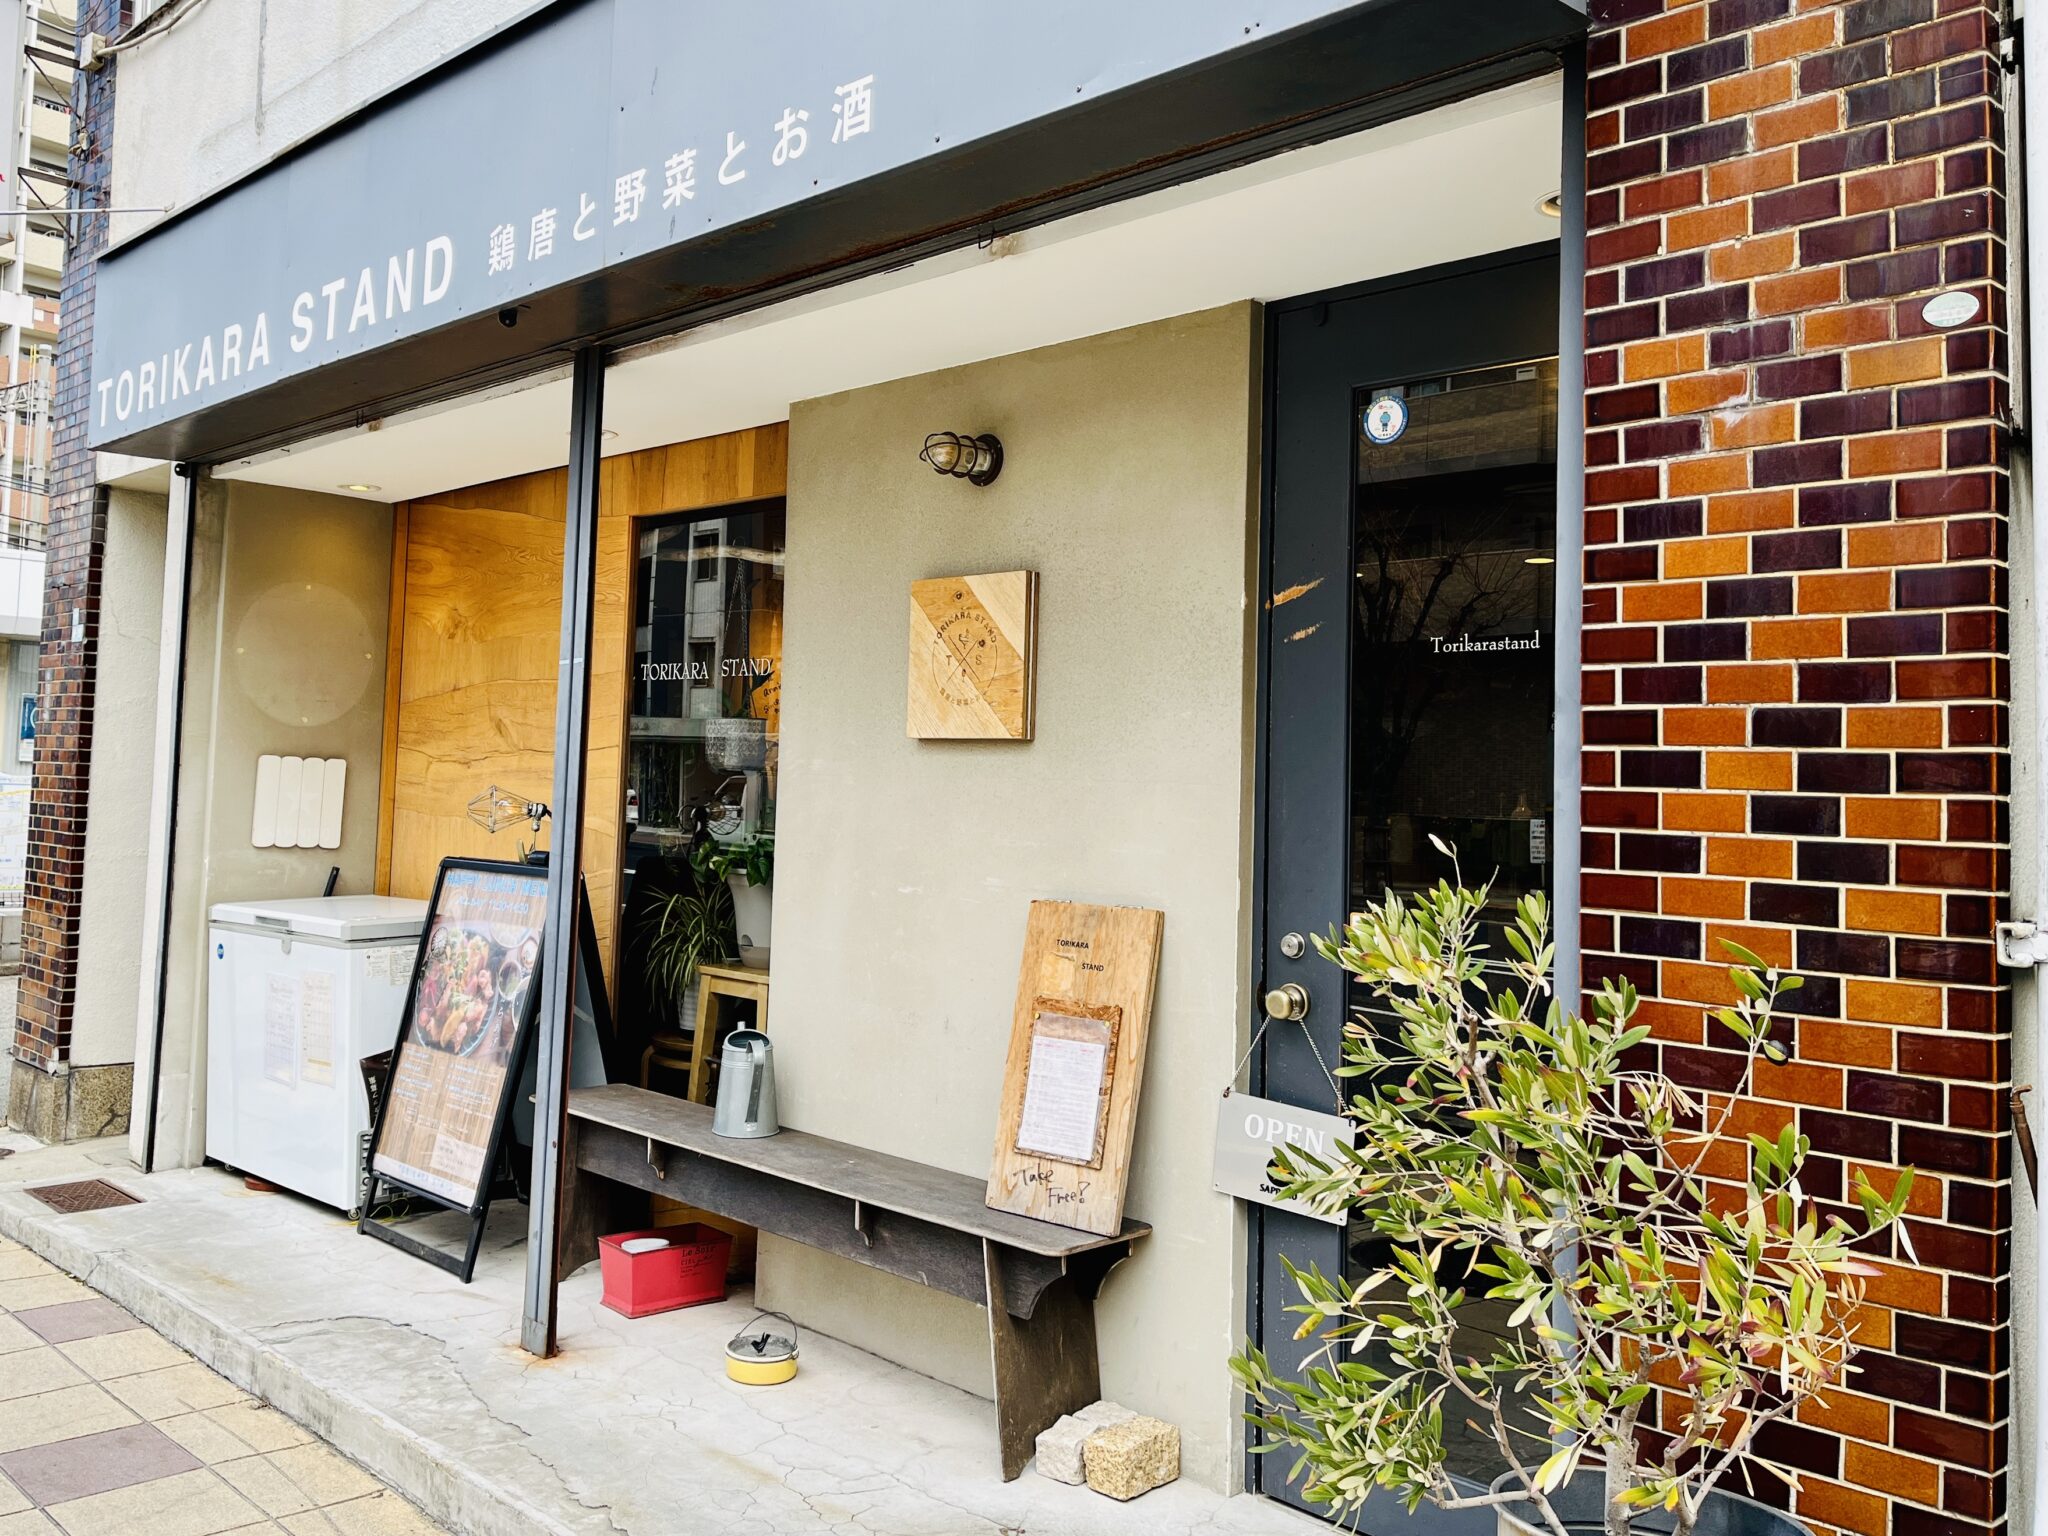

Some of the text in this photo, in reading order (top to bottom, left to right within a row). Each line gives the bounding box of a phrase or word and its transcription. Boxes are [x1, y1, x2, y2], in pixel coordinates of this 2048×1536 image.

[487, 74, 874, 276] 鶏唐と野菜とお酒
[97, 235, 454, 427] TORIKARA STAND
[933, 611, 997, 645] TORIKARA STAND
[1430, 629, 1541, 653] Torikarastand
[640, 658, 771, 681] TORIKARA STAND
[1056, 939, 1089, 949] TORIKARA
[1081, 962, 1105, 972] STAND
[1244, 1113, 1326, 1155] OPEN
[1012, 1162, 1054, 1186] Take
[1260, 1184, 1298, 1200] SAPPO
